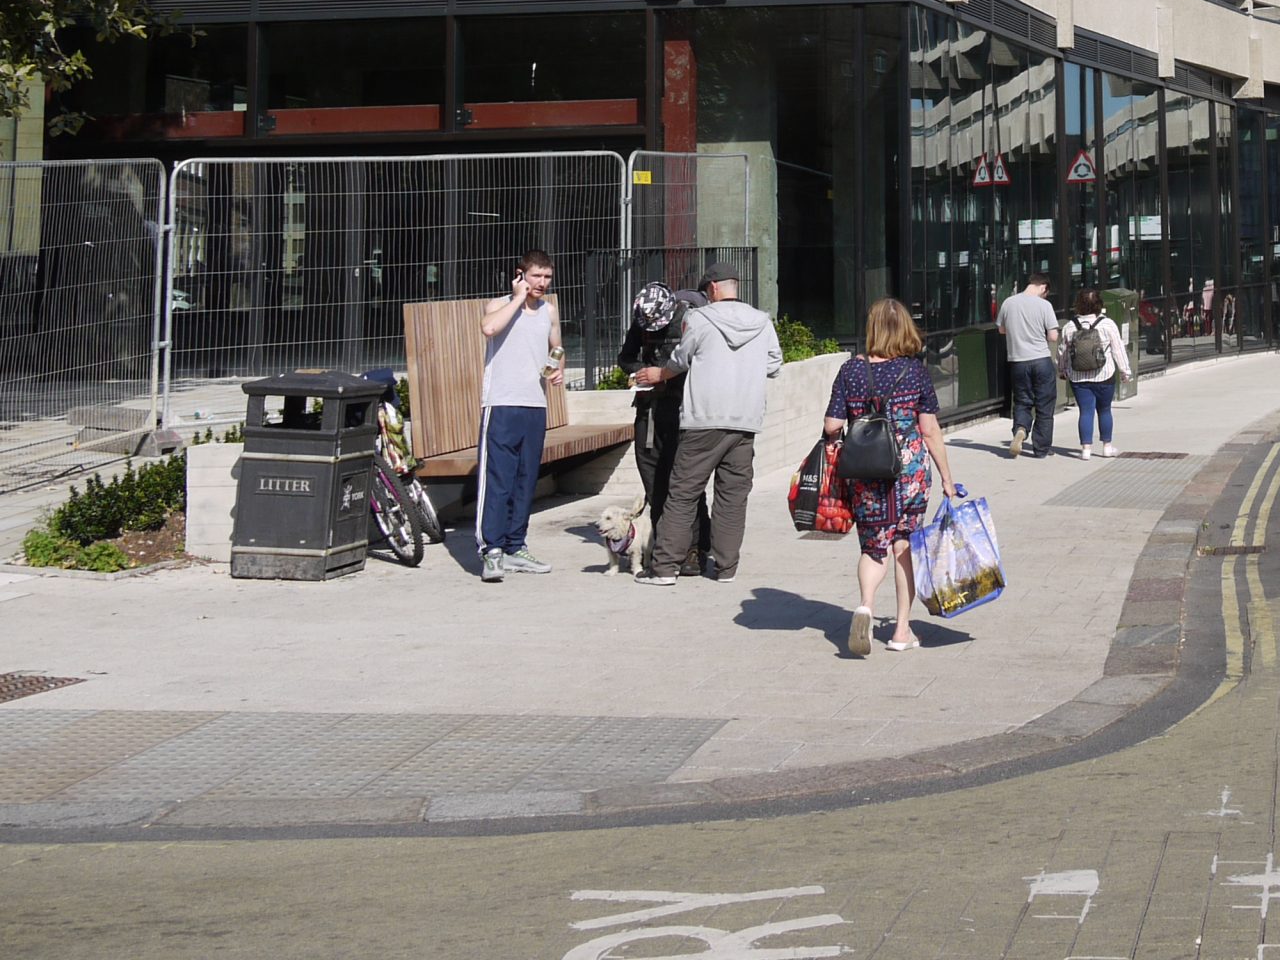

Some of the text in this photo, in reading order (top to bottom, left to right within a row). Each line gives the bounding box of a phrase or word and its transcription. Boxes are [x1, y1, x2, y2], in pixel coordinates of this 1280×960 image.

[802, 474, 818, 483] M&S
[259, 478, 311, 492] LITTER
[351, 491, 364, 501] YORK
